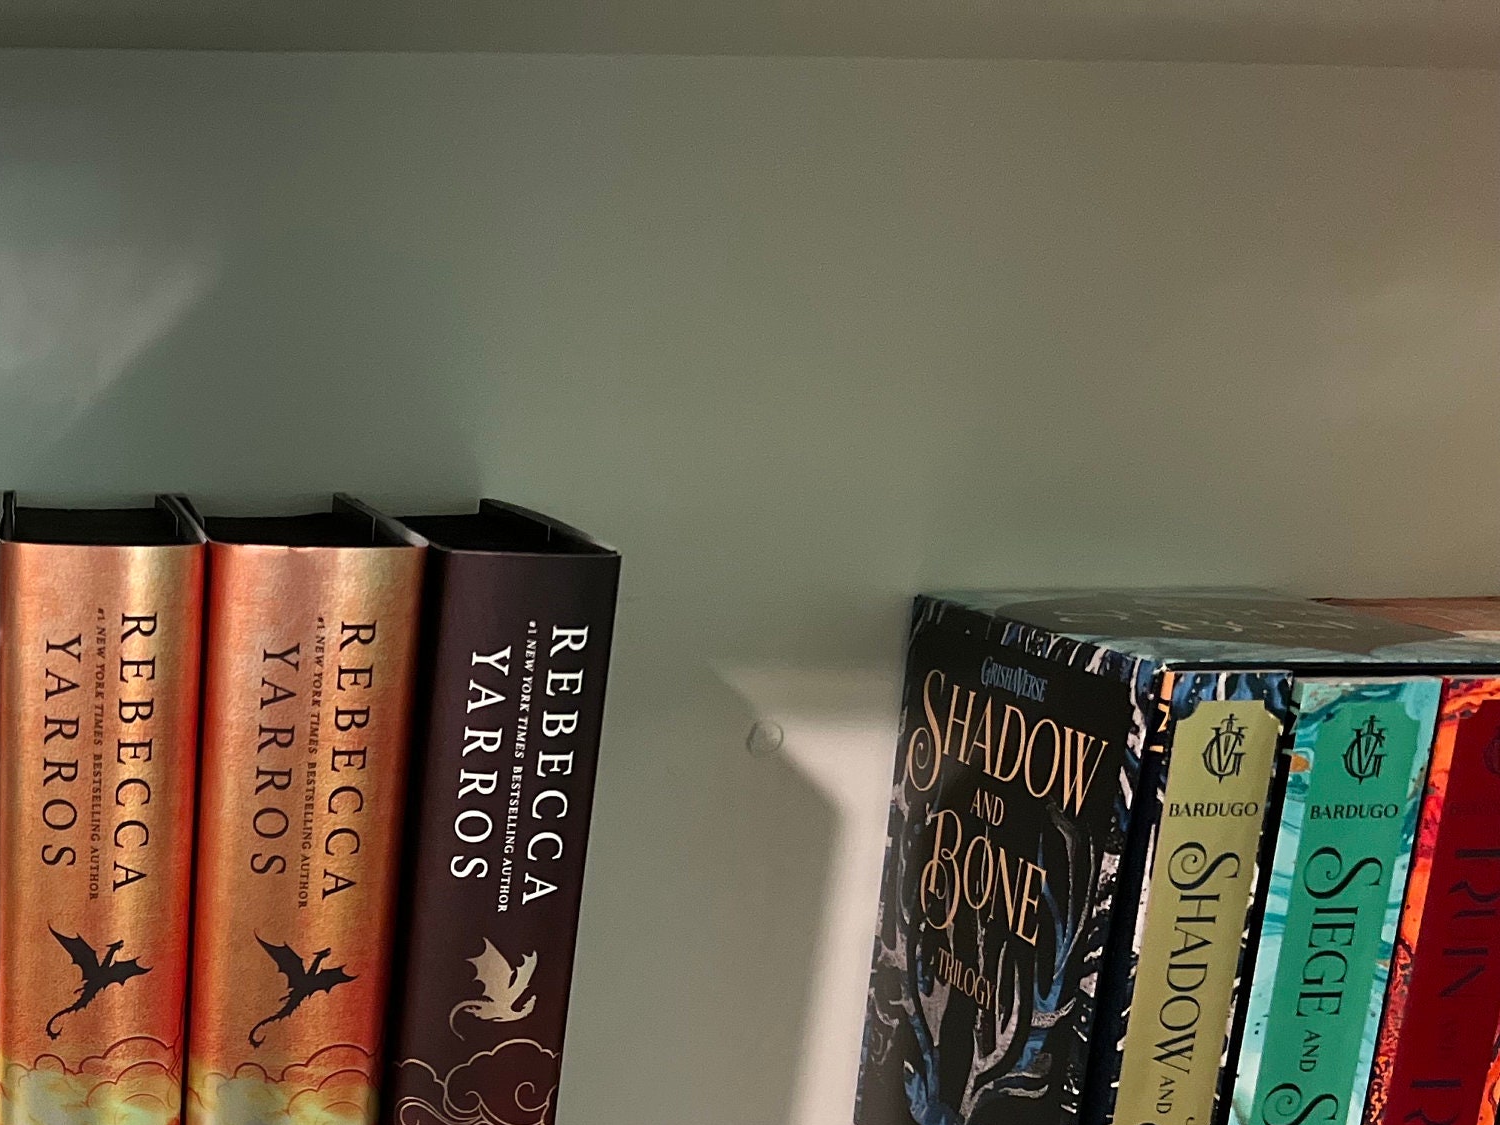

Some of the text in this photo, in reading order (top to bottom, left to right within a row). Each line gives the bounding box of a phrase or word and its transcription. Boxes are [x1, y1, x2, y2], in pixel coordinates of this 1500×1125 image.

[95, 626, 106, 660] NEW
[314, 636, 326, 668] NEW
[524, 639, 537, 672] NEW
[94, 663, 105, 699] YORK
[311, 672, 323, 707] YORK
[519, 676, 534, 712] YORK
[41, 633, 82, 866] YARROS
[93, 704, 104, 746] TIMES
[308, 713, 320, 755] TIMES
[514, 716, 529, 759] TIMES
[908, 668, 1109, 817] SHADOW
[112, 612, 158, 892] REBECCA
[250, 642, 301, 875] YARROS
[321, 619, 377, 900] REBECCA
[450, 645, 512, 879] YARROS
[521, 624, 590, 905] REBECCA
[90, 753, 102, 842] BESTSELLING
[302, 762, 317, 850] BESTSELLING
[503, 766, 524, 854] BESTSELLING
[970, 787, 1004, 826] AND
[1169, 802, 1258, 818] BARDUGO
[1309, 804, 1399, 820] BARDUGO
[89, 848, 100, 900] AUTHOR
[298, 855, 311, 908] AUTHOR
[497, 858, 513, 912] AUTHOR
[920, 808, 1047, 947] BONE
[1152, 841, 1241, 1074] SHADOW
[1296, 846, 1383, 1018] SIEGE
[939, 947, 996, 1010] TRILOGY
[1299, 1029, 1322, 1073] AND
[1156, 1075, 1176, 1114] AND
